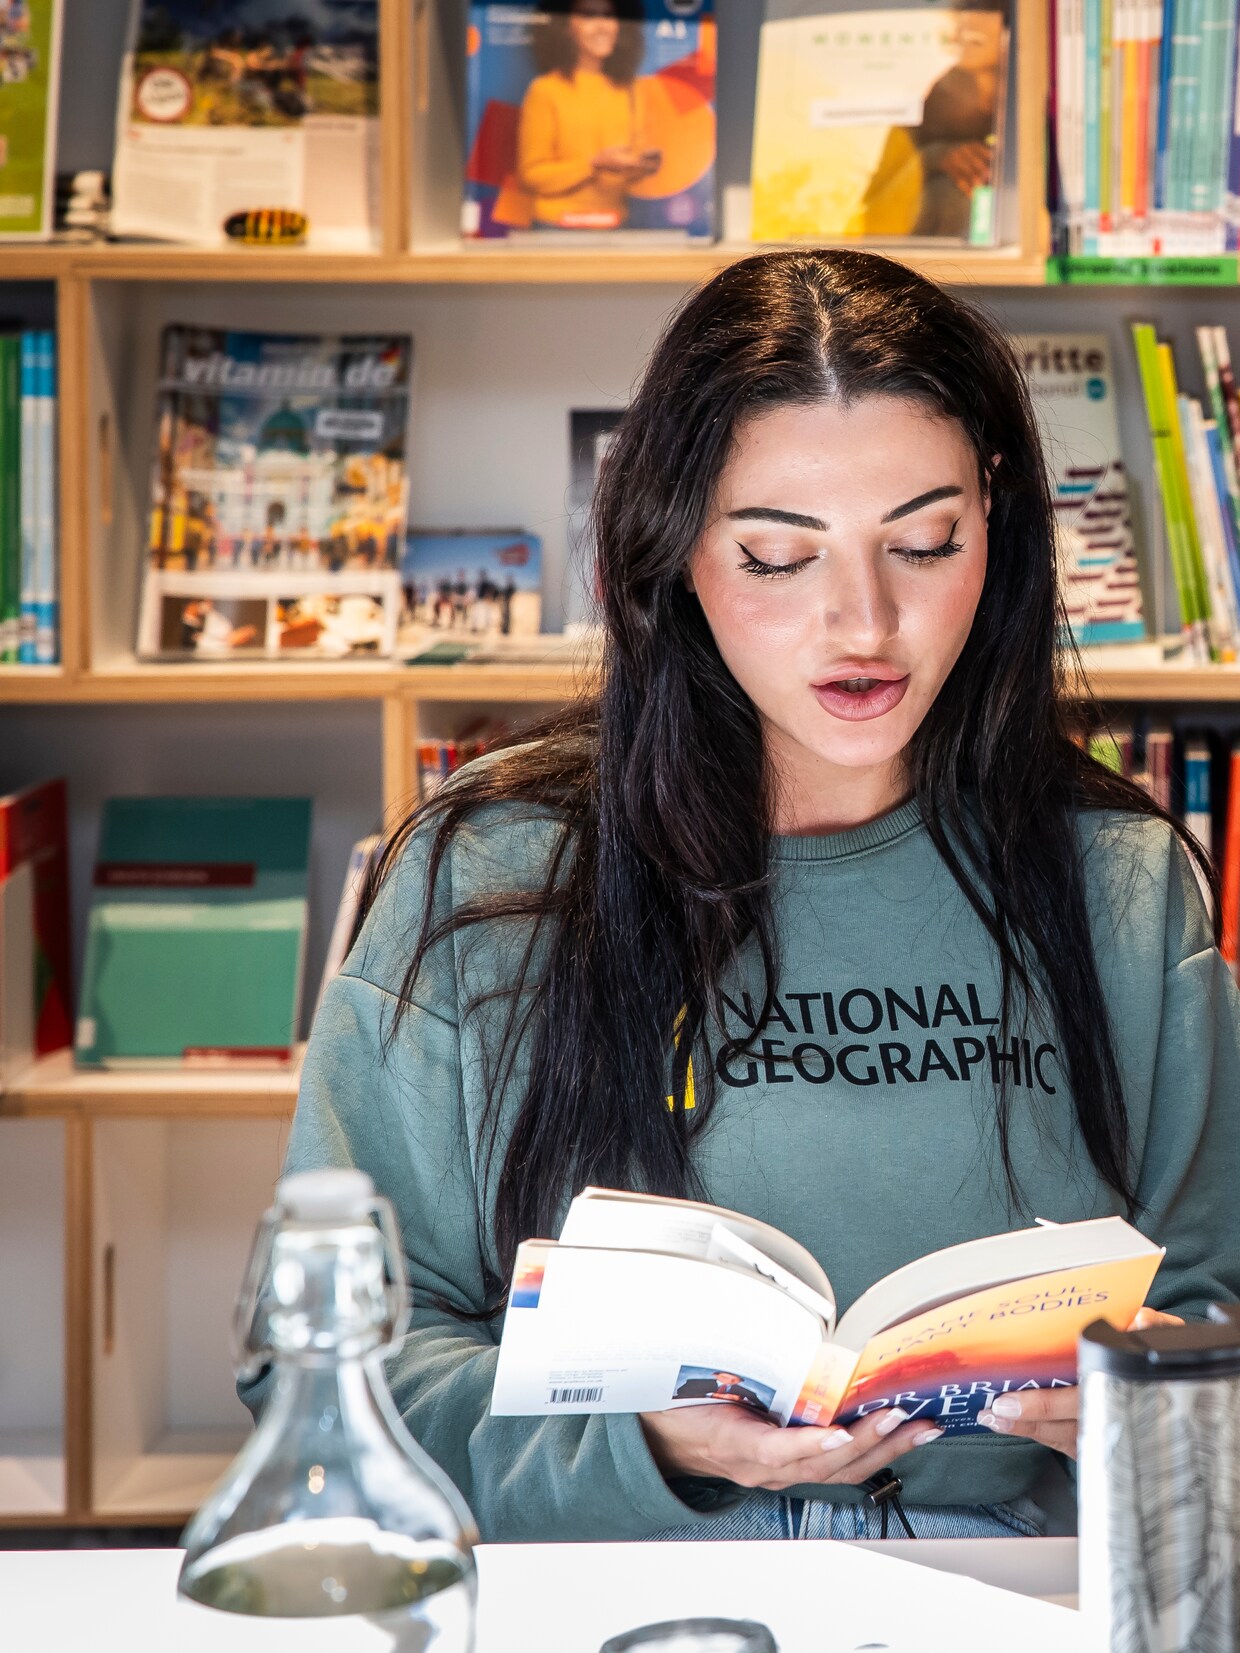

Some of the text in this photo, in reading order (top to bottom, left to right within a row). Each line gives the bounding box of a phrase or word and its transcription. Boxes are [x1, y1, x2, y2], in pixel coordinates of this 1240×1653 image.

[1024, 341, 1105, 374] ritte
[719, 983, 1000, 1035] NATIONAL
[715, 1034, 1058, 1096] GEOGRAPHIC
[878, 1290, 1109, 1361] MANY BODIES
[901, 1310, 983, 1342] SAME
[856, 1391, 921, 1416] DR
